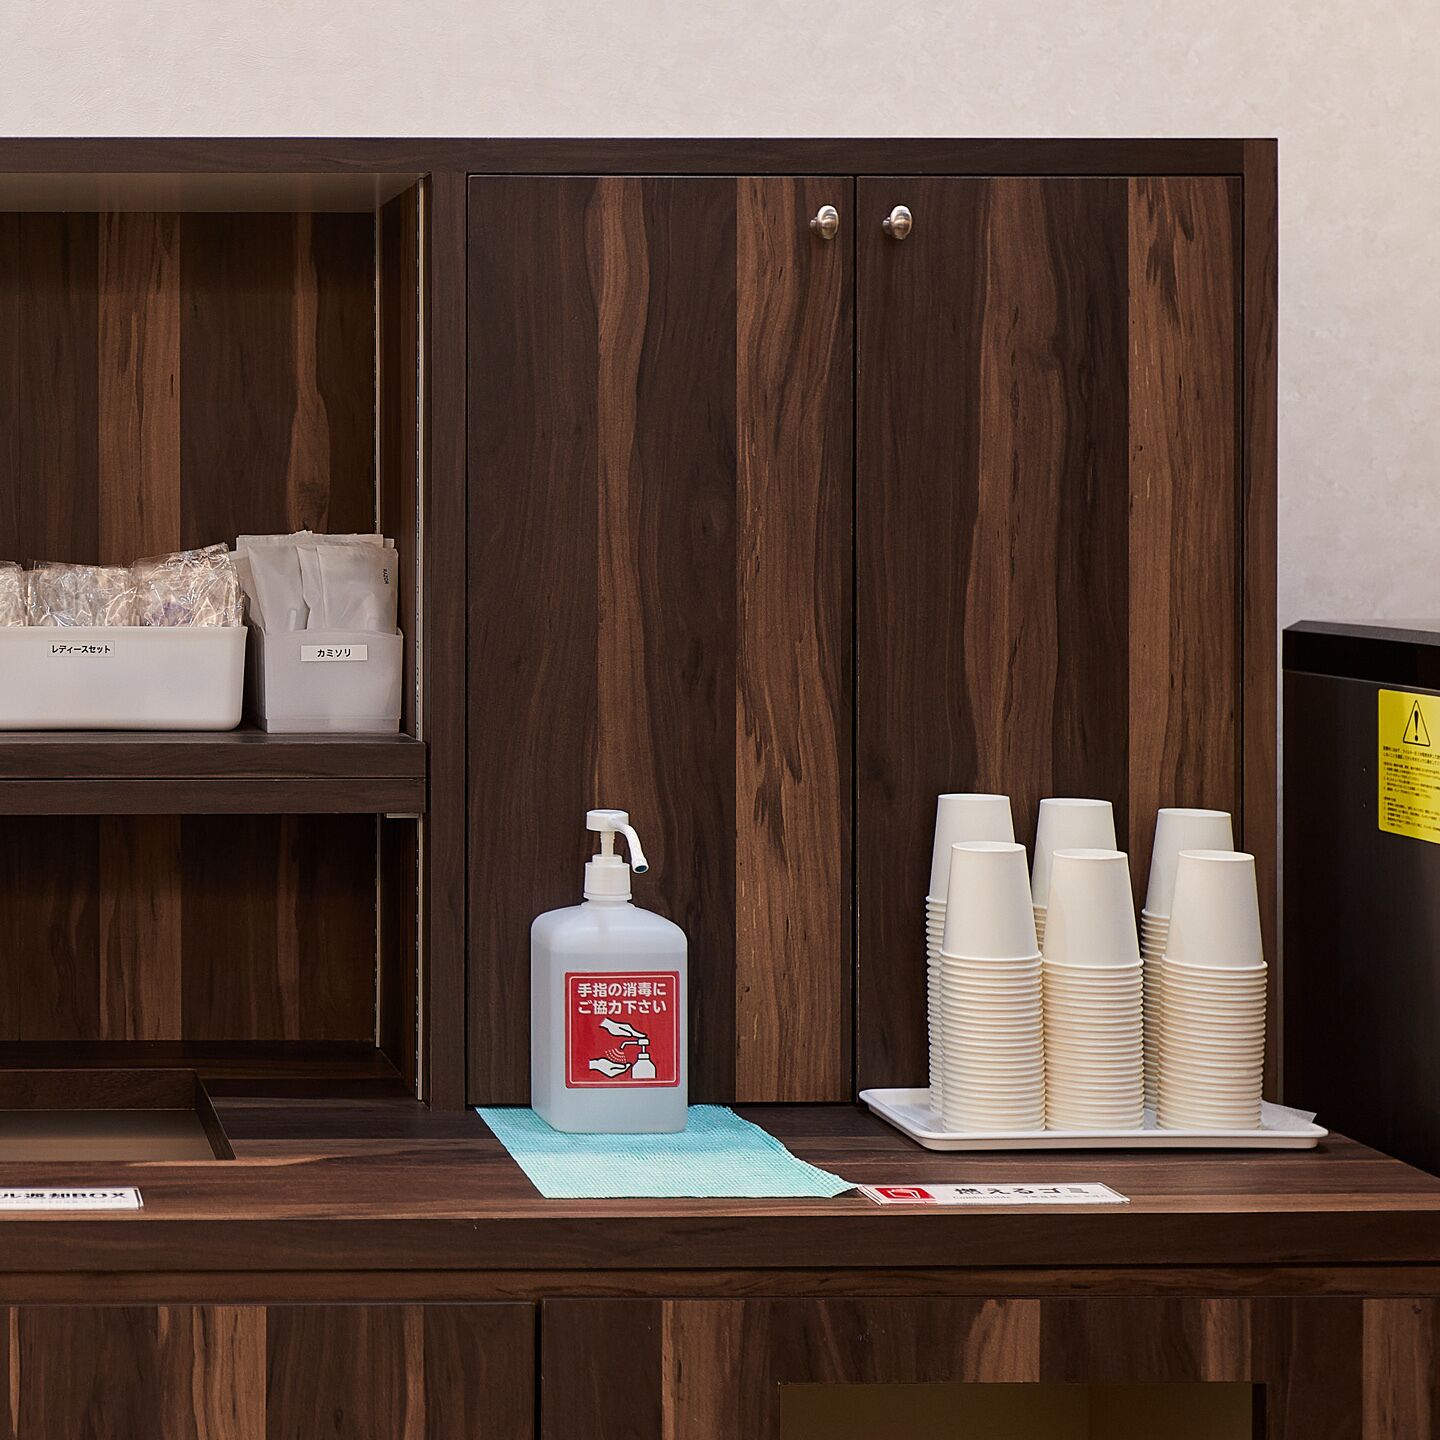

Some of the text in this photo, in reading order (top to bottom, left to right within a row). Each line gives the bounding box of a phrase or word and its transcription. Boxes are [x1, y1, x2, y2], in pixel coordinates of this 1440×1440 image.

[51, 644, 111, 654] レディースセット
[317, 648, 351, 658] カミソリ
[577, 982, 667, 998] 手指の消毒に
[577, 999, 667, 1015] ご協力下さい
